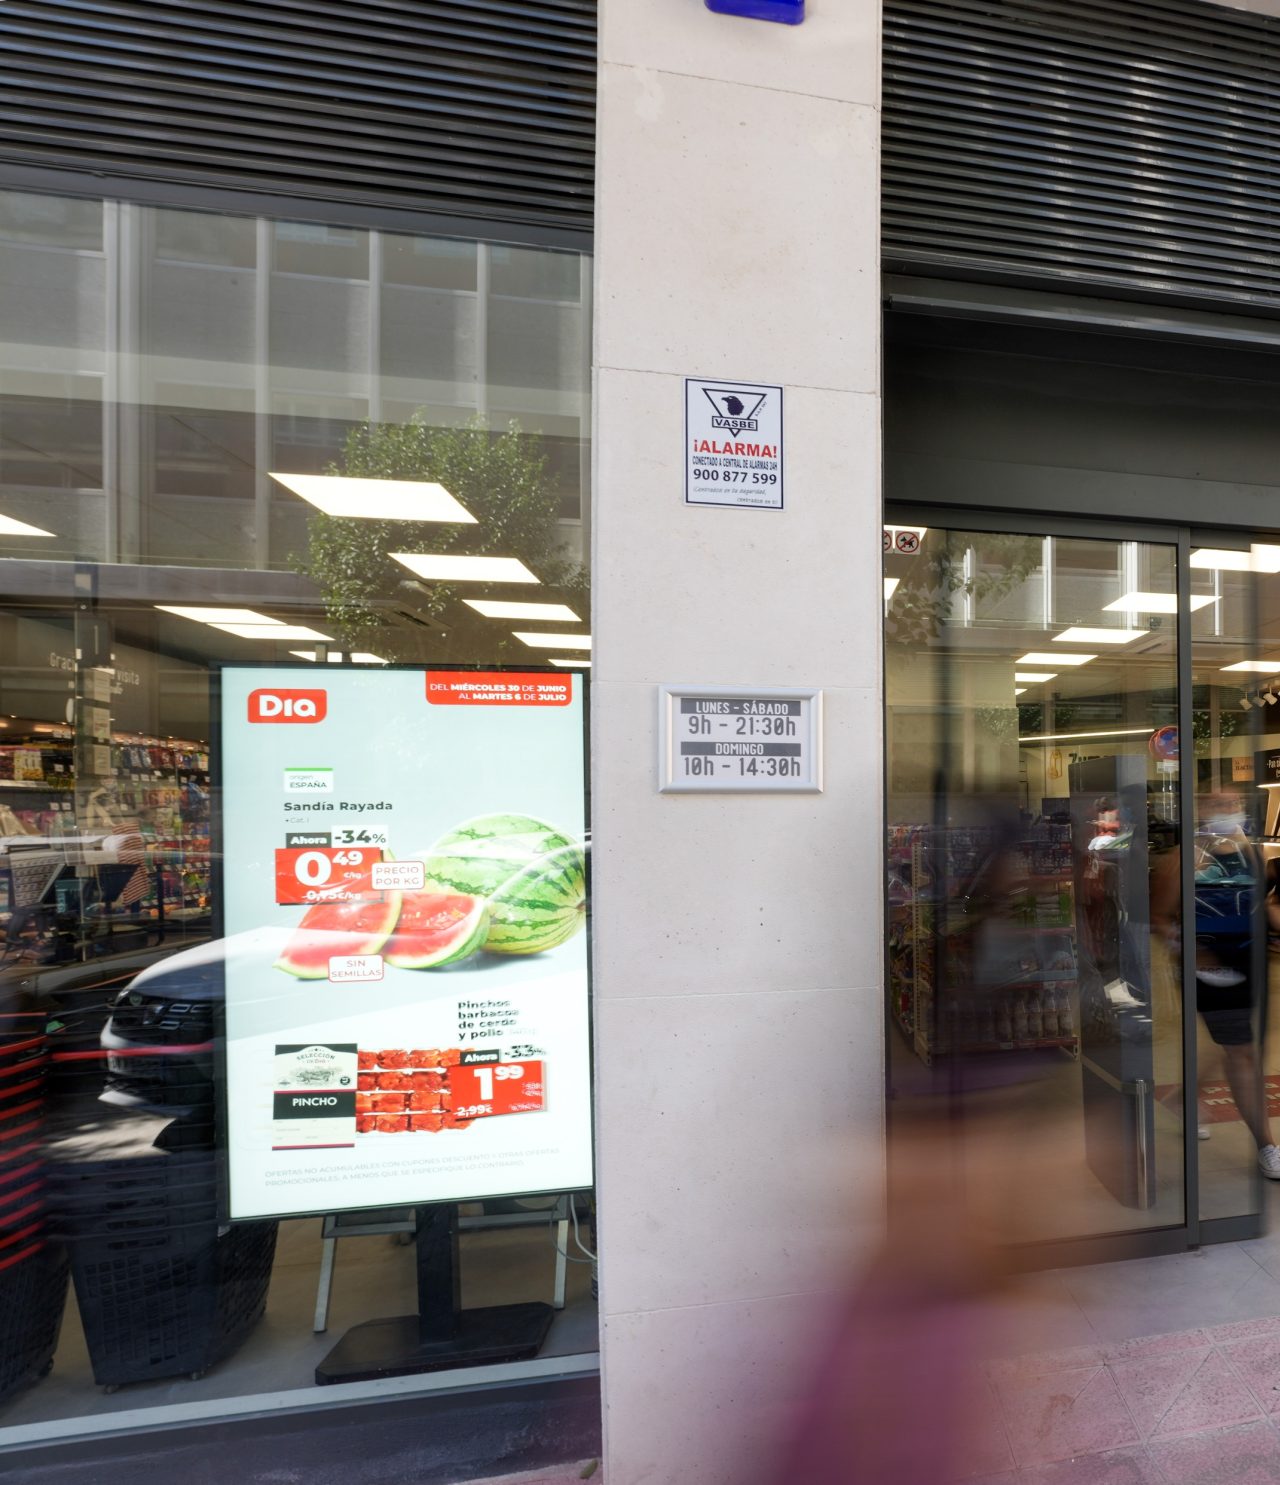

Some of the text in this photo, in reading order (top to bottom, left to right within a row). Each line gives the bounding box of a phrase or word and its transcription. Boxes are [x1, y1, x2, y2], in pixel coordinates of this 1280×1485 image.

[715, 418, 755, 429] VASBE
[694, 439, 777, 458] ¡ALARMA!
[692, 456, 718, 466] CONECTADO
[723, 458, 742, 468] CENTRAL
[743, 460, 749, 468] DE
[749, 460, 769, 470] ALARMAS
[693, 468, 777, 485] 900 877 599
[117, 670, 140, 686] visita
[451, 683, 506, 692] MIÉRCOLES
[472, 693, 513, 701] MARTES
[523, 693, 536, 701] DE
[696, 701, 730, 714] LUNES
[743, 700, 789, 715] SÁBADO
[688, 715, 711, 734] 9h
[736, 716, 796, 736] 21:30h
[715, 743, 764, 755] DOMINGO
[684, 756, 714, 776] 10h
[739, 756, 801, 777] 14:30h
[290, 780, 328, 788] ESPAÑA
[284, 801, 393, 812] Sandía Rayada
[290, 836, 328, 845] Ahora
[334, 830, 387, 844] -34%
[294, 850, 363, 886] 0 49
[404, 877, 419, 885] KG
[331, 969, 382, 977] SEMILLAS
[458, 1000, 511, 1009] Pinchos
[458, 1010, 520, 1019] barbacoa
[458, 1019, 517, 1029] de cerdo
[458, 1032, 466, 1041] y
[471, 1029, 504, 1040] pollo
[296, 1052, 336, 1061] SELECCIÓN
[465, 1053, 498, 1063] Ahora
[473, 1067, 493, 1100] 1
[494, 1065, 525, 1081] 99
[292, 1097, 338, 1107] PINCHO
[265, 1169, 303, 1178] OFERTAS
[319, 1162, 380, 1173] ACUMULABLES
[382, 1160, 400, 1168] CON
[401, 1157, 441, 1166] CUPONES
[441, 1153, 490, 1163] DESCUENTO
[498, 1151, 524, 1159] OTRAS
[524, 1147, 560, 1156] OFERTAS
[350, 1171, 380, 1179] MENOS
[380, 1170, 398, 1178] QUE
[412, 1164, 463, 1175] ESPECIFIQUE
